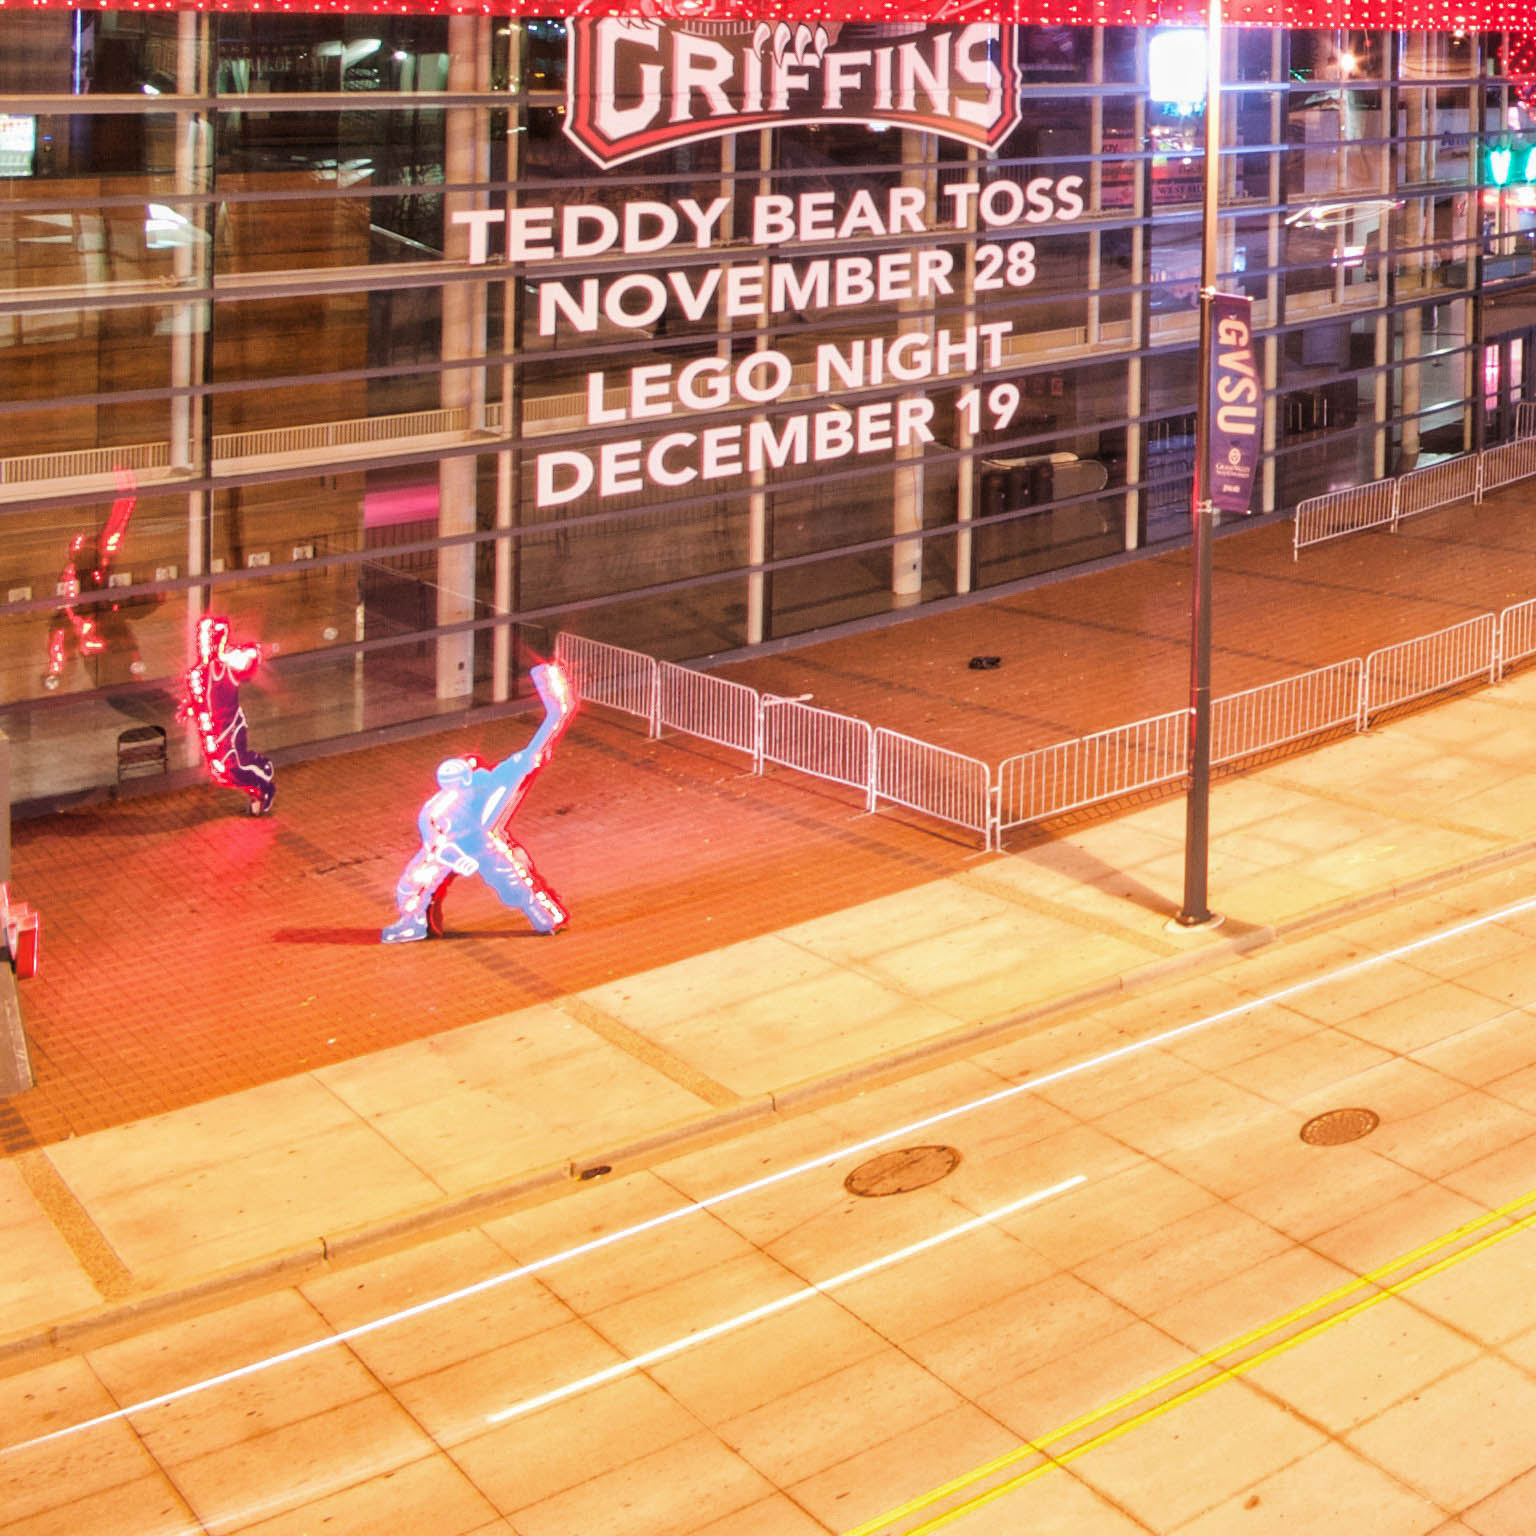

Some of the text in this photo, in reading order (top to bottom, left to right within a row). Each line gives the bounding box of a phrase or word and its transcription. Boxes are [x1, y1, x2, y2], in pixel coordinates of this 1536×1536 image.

[595, 19, 1001, 140] GRIFFINS
[451, 176, 1084, 265] TEDDY BEAR TOSS
[540, 241, 1036, 336] NOVEMBER 28
[587, 321, 1014, 426] LEGO NIGHT
[1217, 318, 1257, 434] GVSU
[536, 383, 1021, 508] DECEMBER 19
